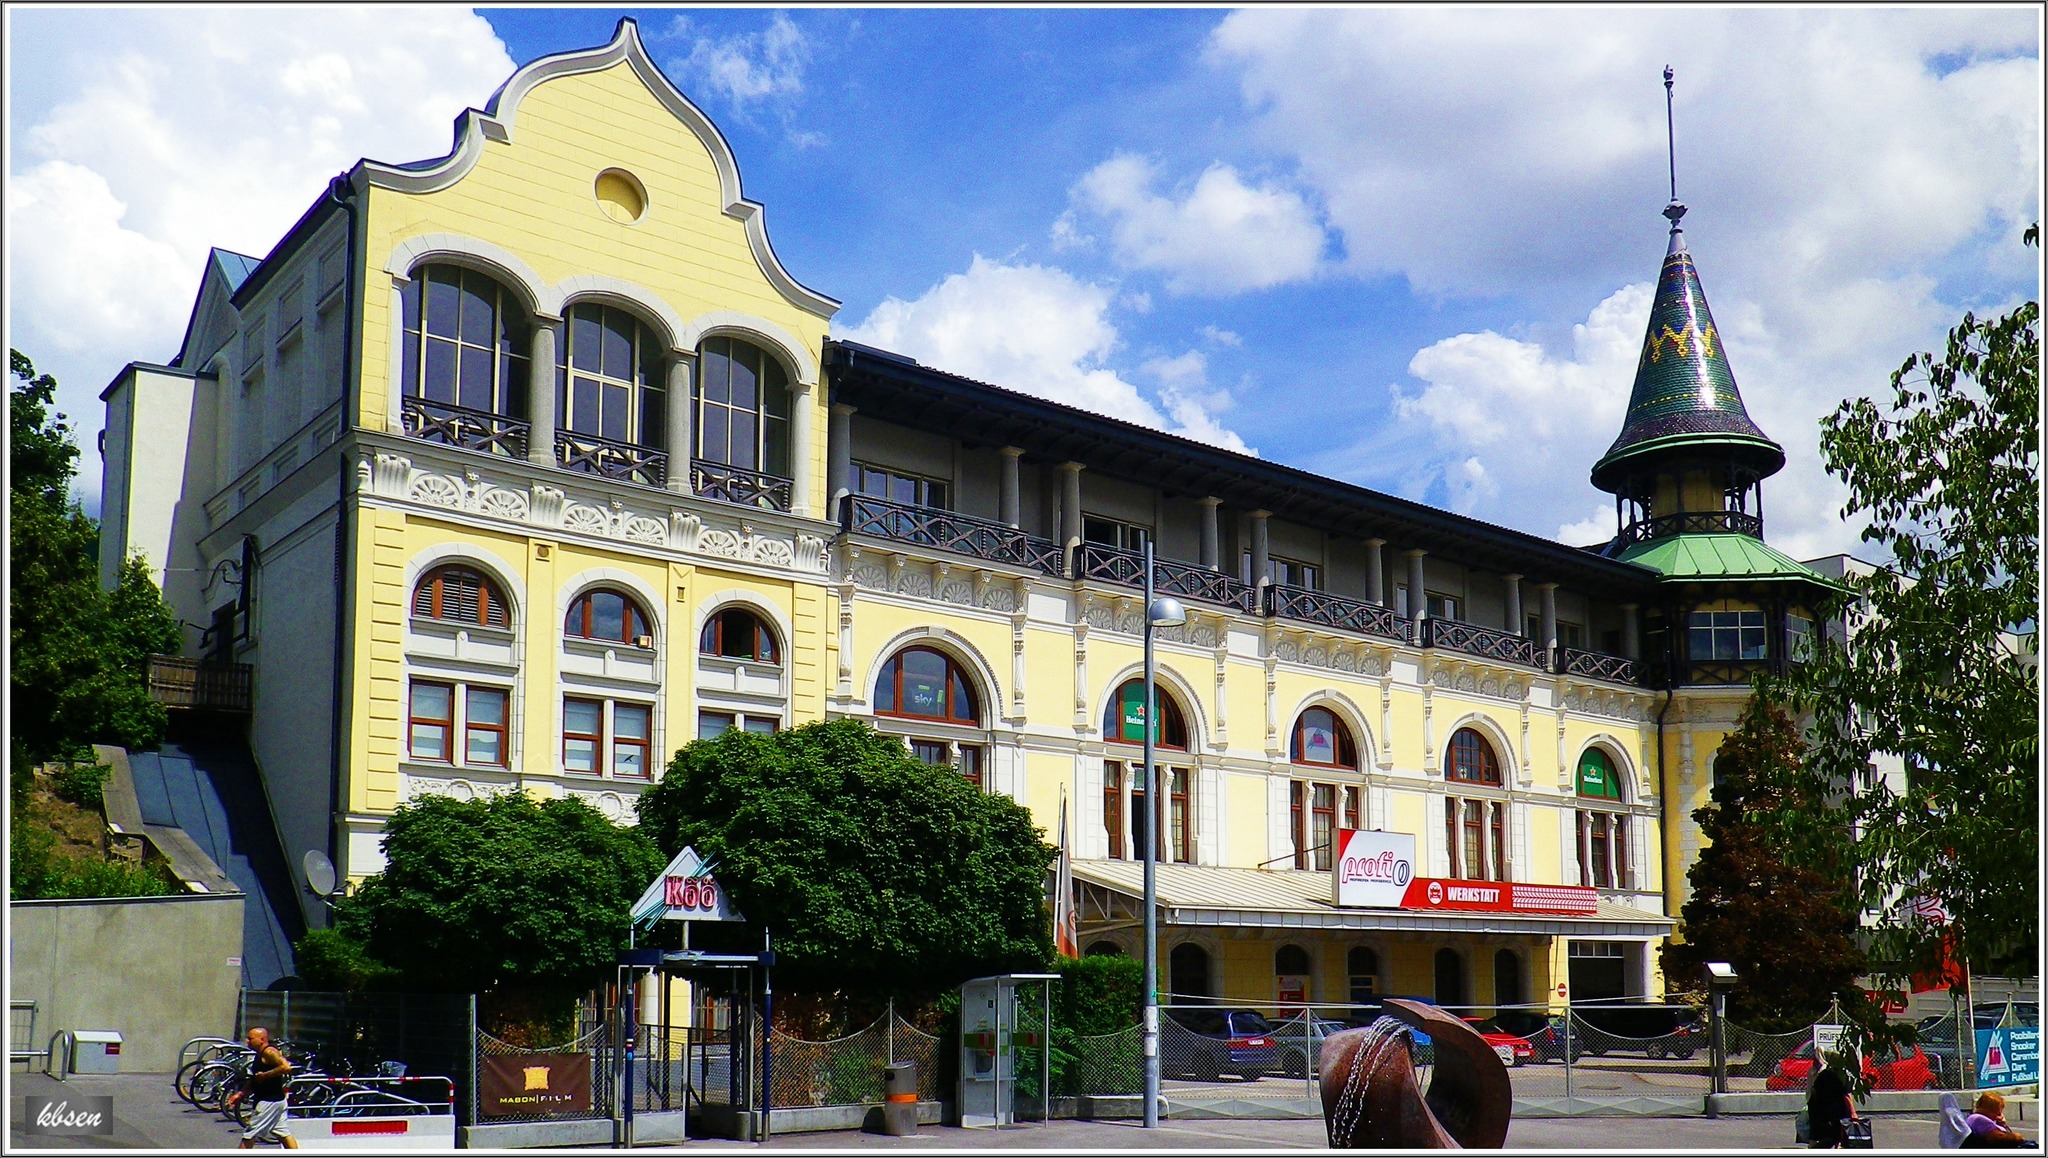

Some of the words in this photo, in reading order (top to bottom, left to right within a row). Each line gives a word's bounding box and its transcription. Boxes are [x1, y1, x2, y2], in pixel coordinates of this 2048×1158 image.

[914, 693, 932, 707] sky
[665, 875, 715, 907] Köö
[1447, 886, 1500, 903] WERKSTATT
[2010, 1041, 2036, 1051] Snooker
